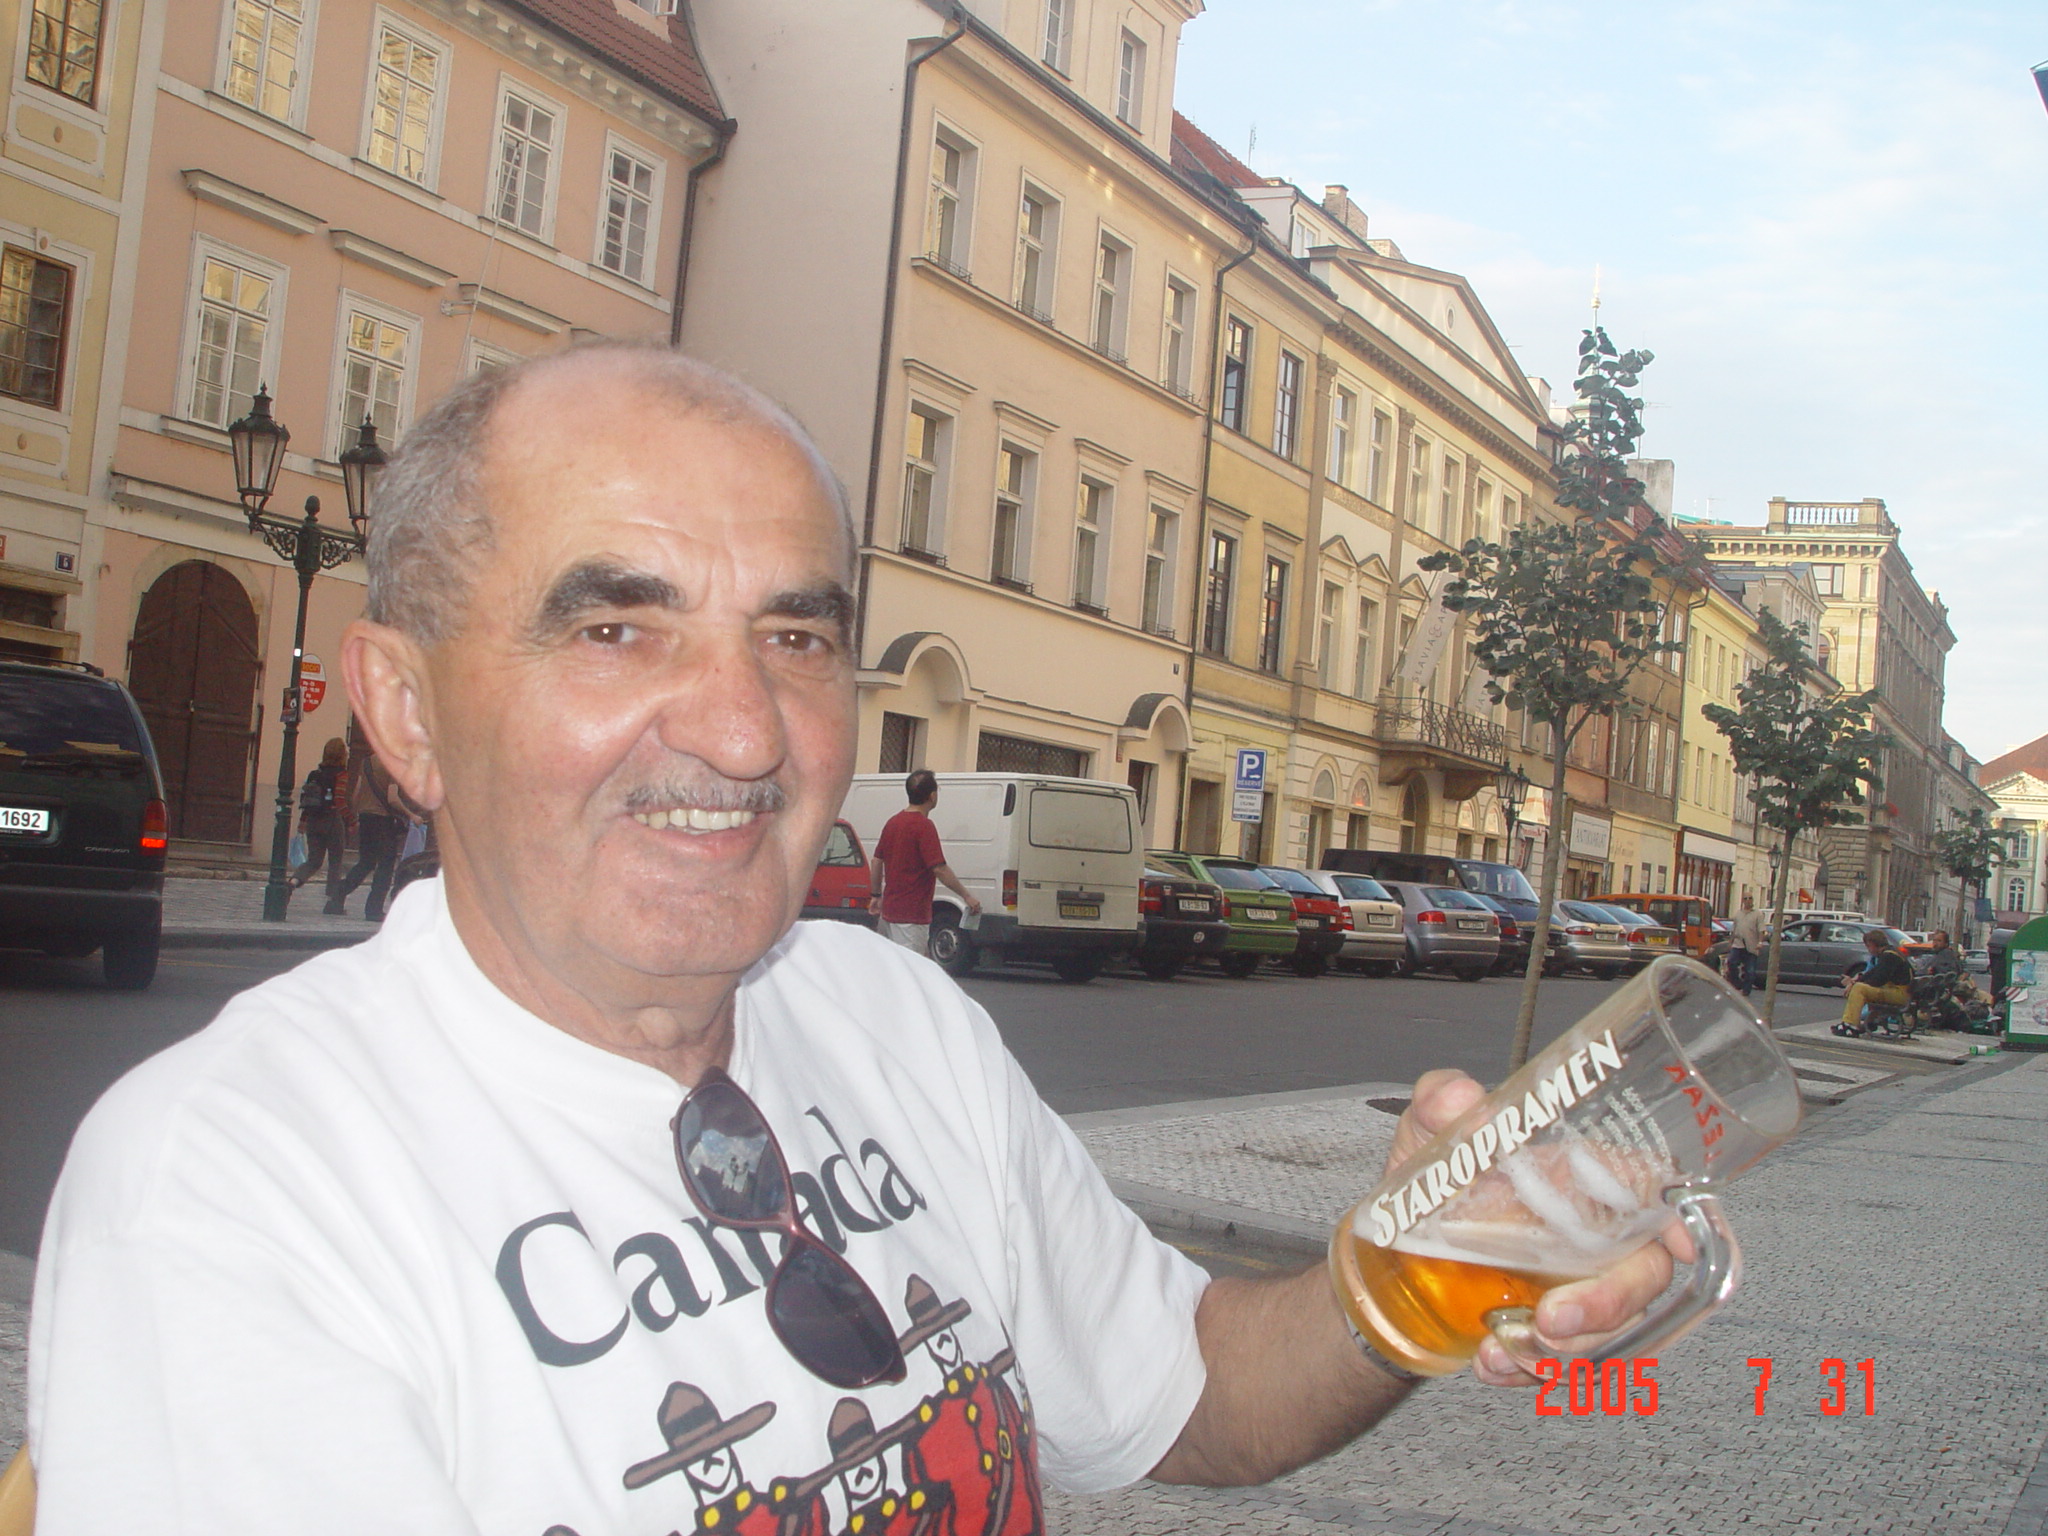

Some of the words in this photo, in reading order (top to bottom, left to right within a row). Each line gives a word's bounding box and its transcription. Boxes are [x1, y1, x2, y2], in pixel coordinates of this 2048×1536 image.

[2, 810, 41, 828] 1692
[1241, 754, 1260, 778] P
[1370, 1029, 1623, 1248] STAROPRAMEN
[494, 1105, 928, 1368] Canada
